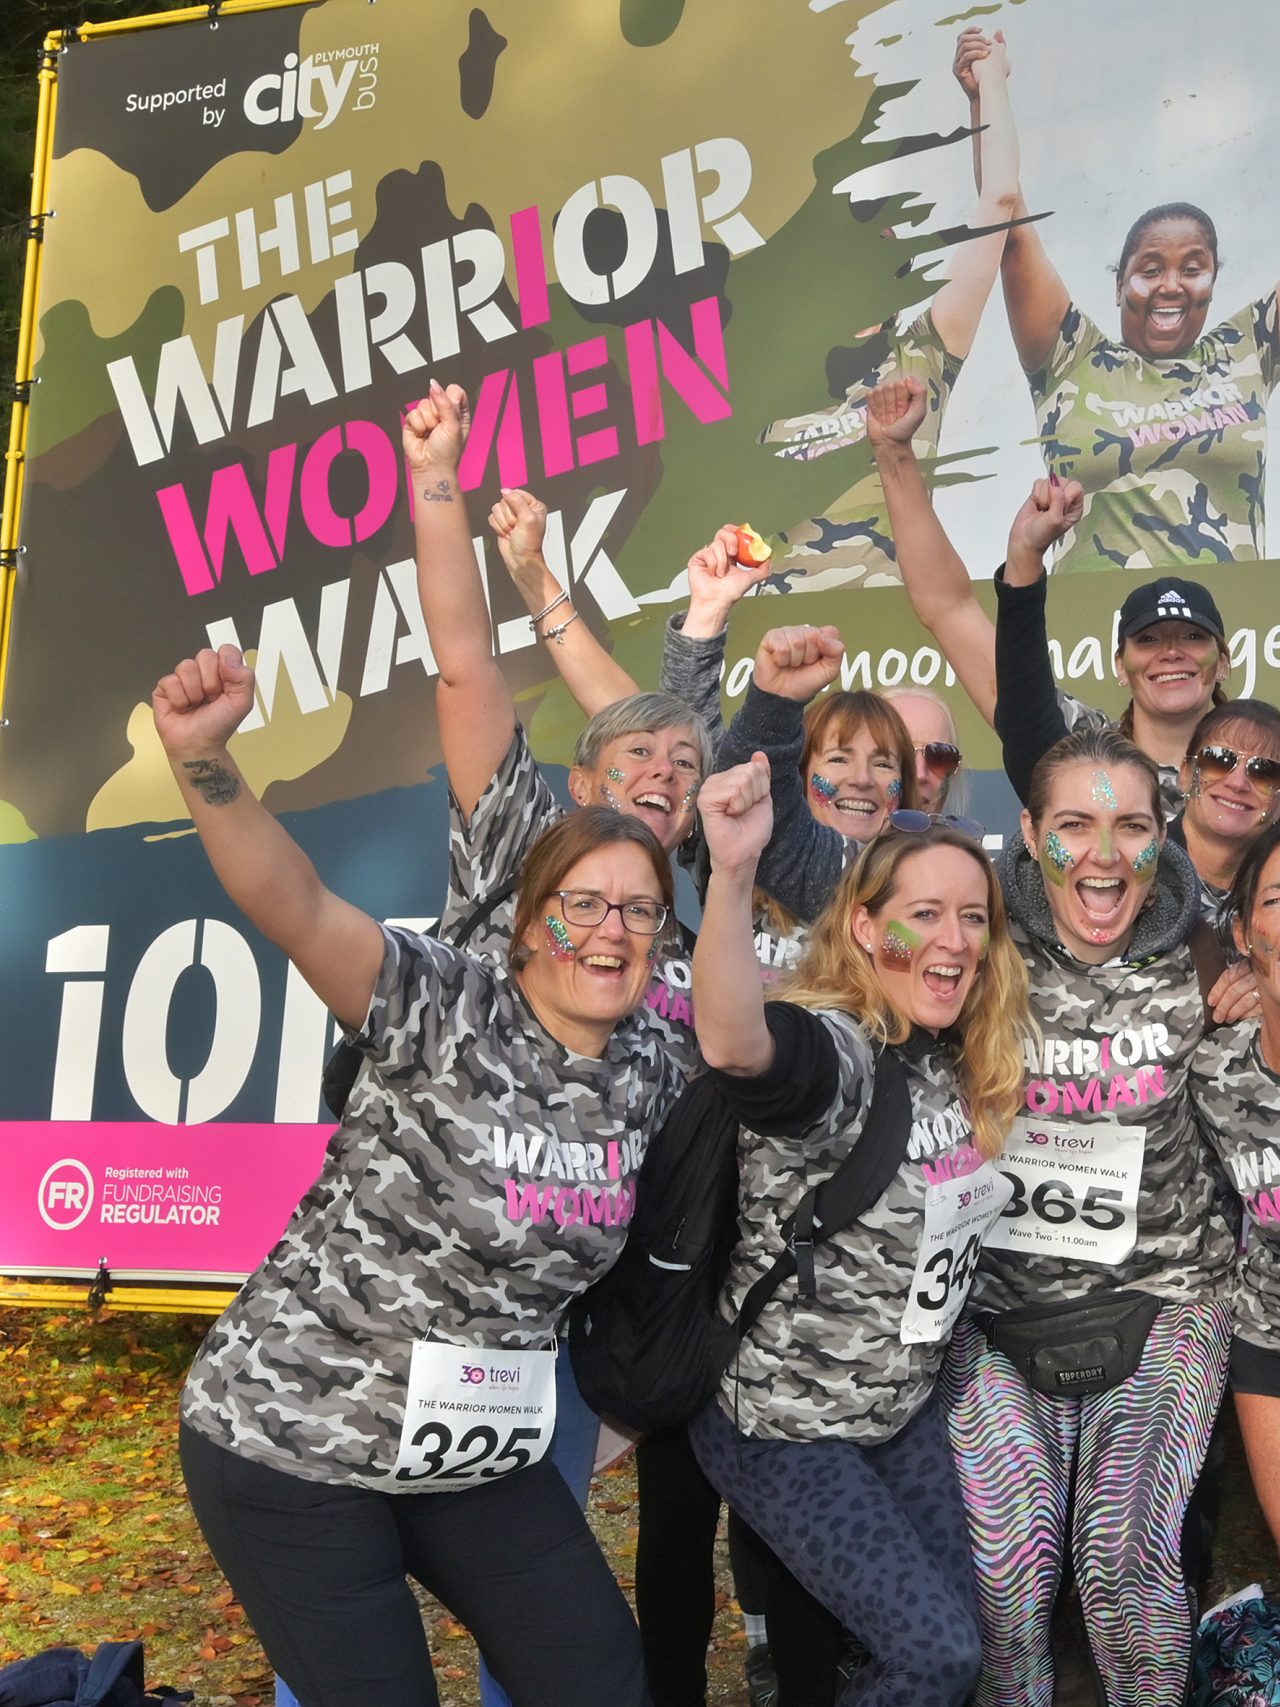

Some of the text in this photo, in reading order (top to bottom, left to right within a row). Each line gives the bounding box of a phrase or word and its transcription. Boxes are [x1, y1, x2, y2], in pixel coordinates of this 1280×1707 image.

[315, 43, 379, 63] PLYMOUTH
[243, 52, 359, 130] city
[352, 56, 378, 111] bus
[125, 78, 226, 113] Supported
[203, 106, 225, 127] by
[178, 169, 360, 305] THE
[106, 137, 766, 466] WARRIOR
[1126, 401, 1250, 448] WOMAN
[1023, 1023, 1175, 1076] ARRIOR
[1026, 1064, 1167, 1114] OMAN
[1054, 1135, 1094, 1149] trevi
[105, 1167, 189, 1179] Registered with
[1009, 1154, 1056, 1168] WARRIOR
[1058, 1162, 1097, 1175] WOMEN
[1100, 1168, 1128, 1179] WALK
[48, 1182, 85, 1209] FR
[102, 1184, 222, 1204] FUNDRAISING
[974, 1177, 994, 1200] trevi
[100, 1204, 220, 1226] REGULATOR
[930, 1232, 944, 1242] THE
[1008, 1227, 1032, 1239] Wave
[1035, 1231, 1053, 1242] Two
[1061, 1235, 1098, 1248] 11.00am
[489, 1366, 520, 1383] trevi
[1060, 1367, 1102, 1381] SUPERDRY
[418, 1400, 544, 1414] THE WARRIOR WOMEN WALK
[395, 1422, 541, 1481] 325
